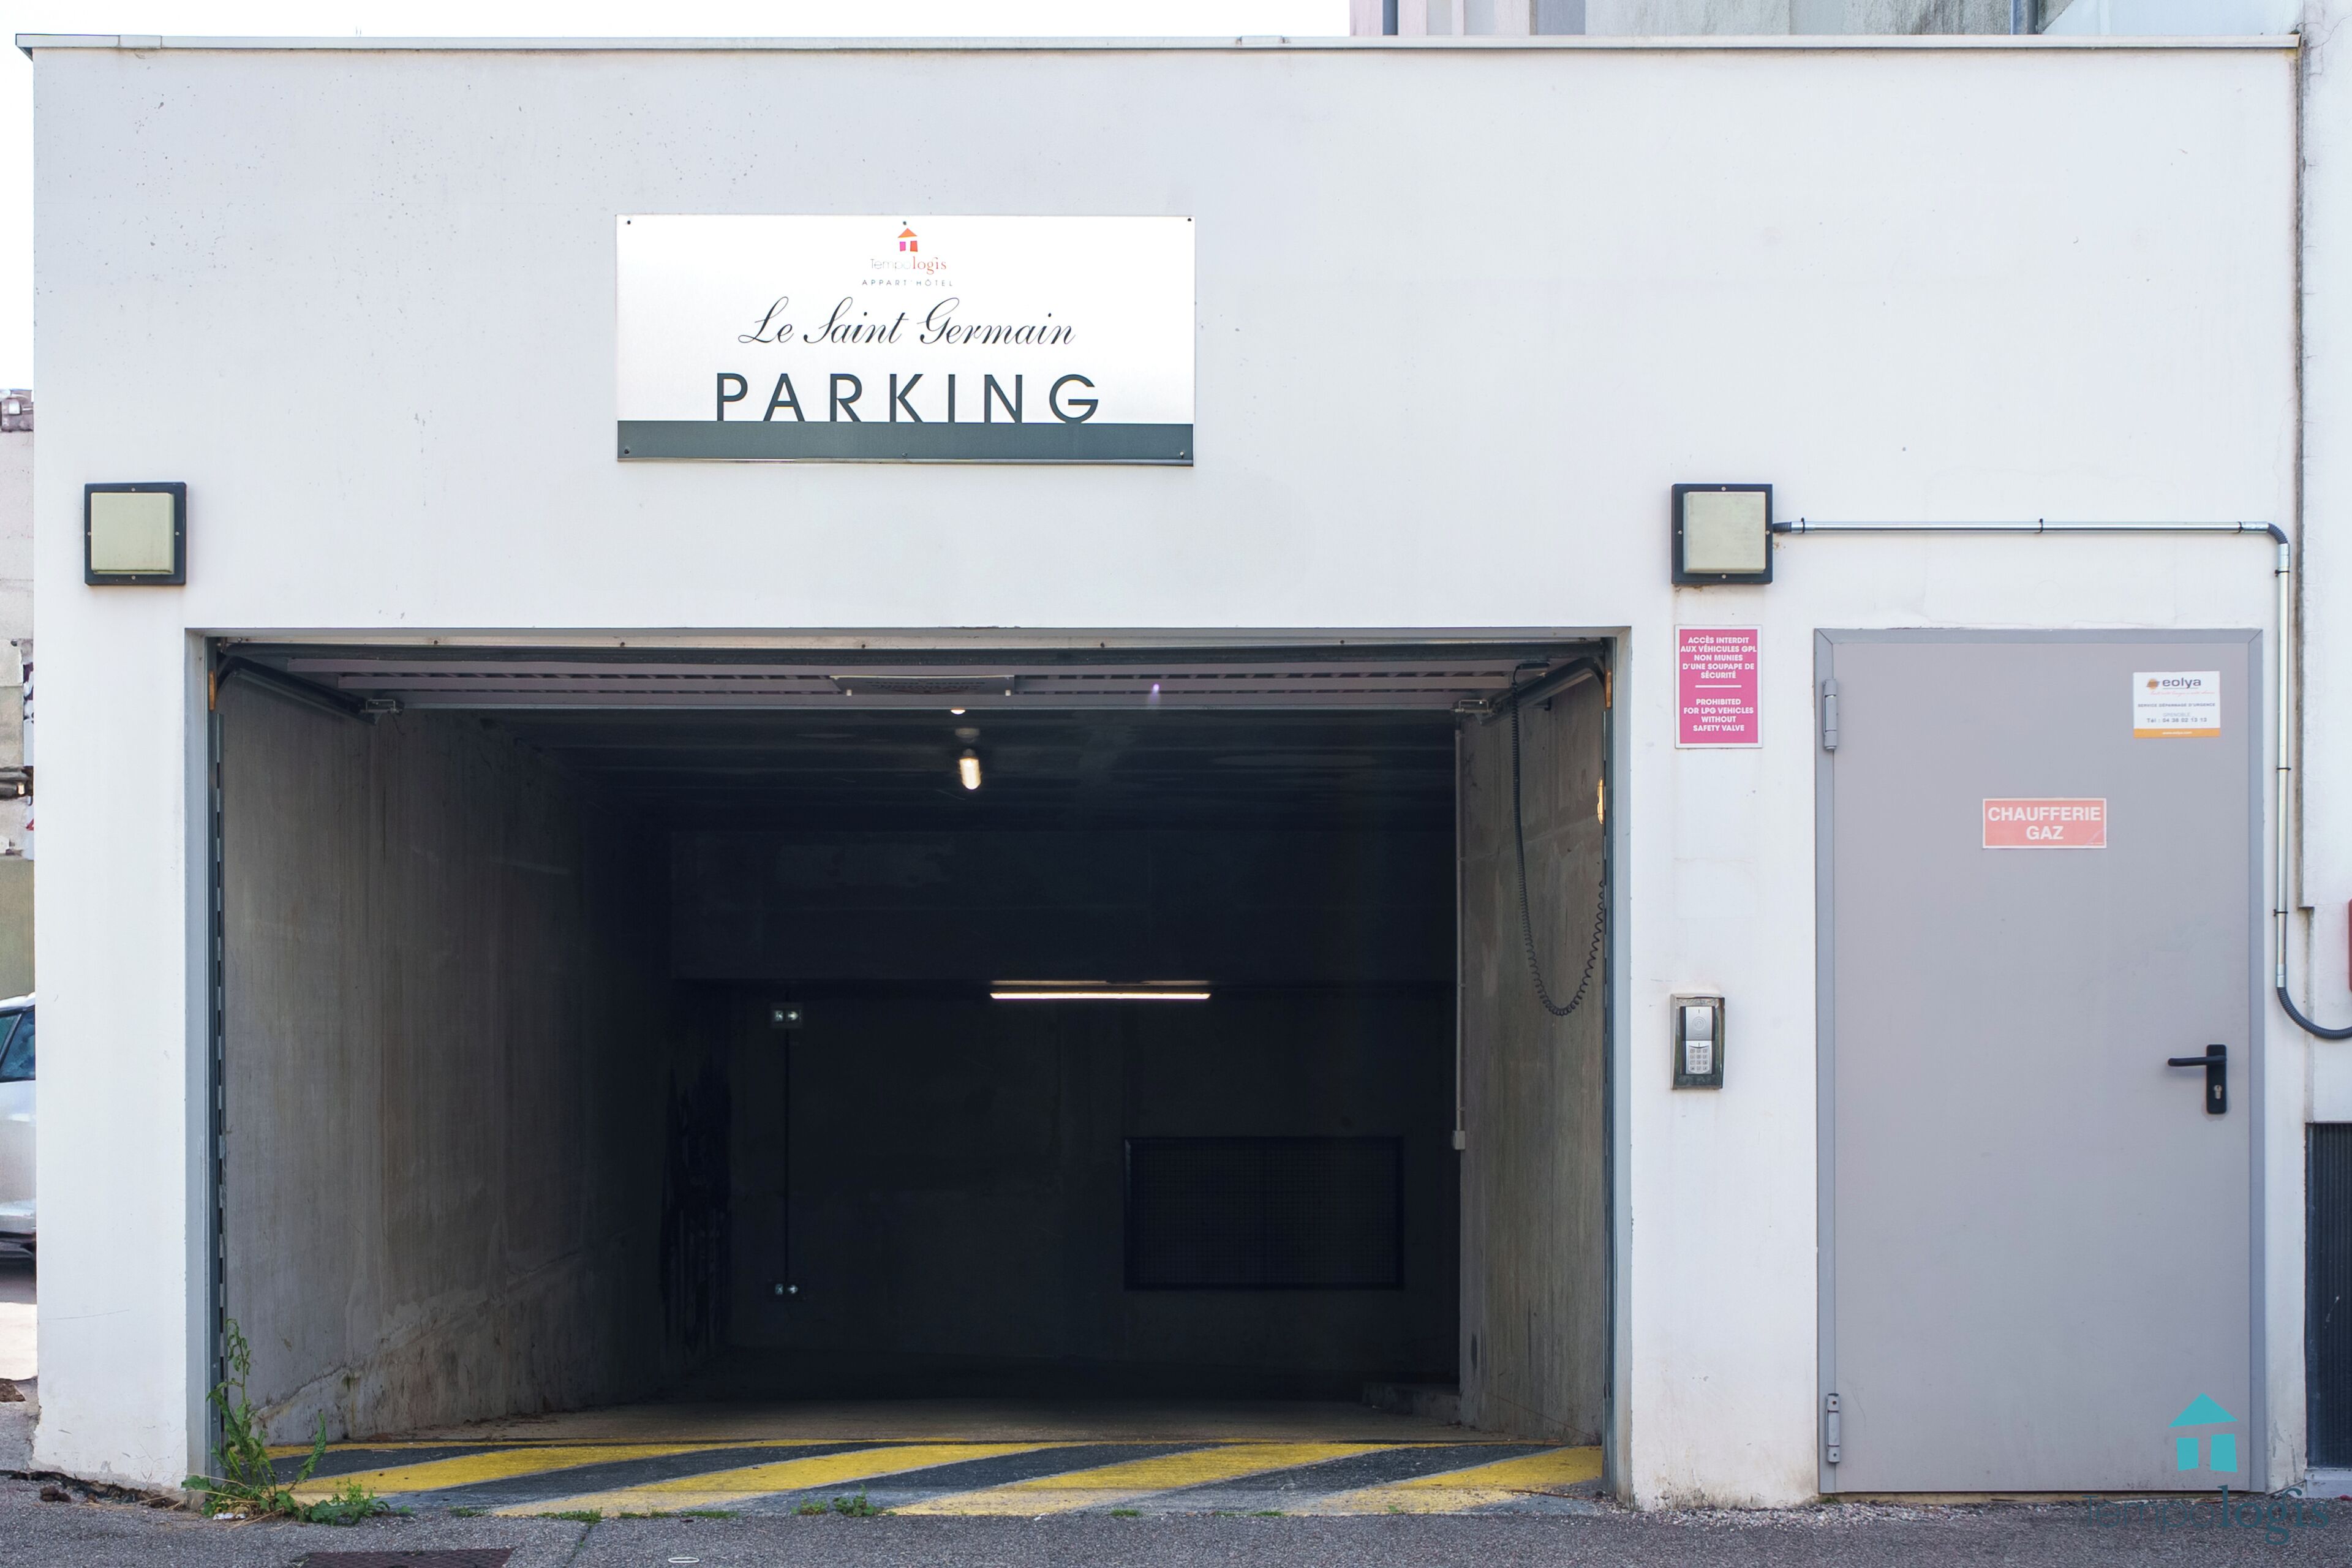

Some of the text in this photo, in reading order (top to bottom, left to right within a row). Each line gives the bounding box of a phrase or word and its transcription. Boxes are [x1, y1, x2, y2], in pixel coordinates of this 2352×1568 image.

[870, 256, 947, 275] Tempologis
[738, 296, 1077, 345] Le Saint Germain
[717, 372, 1099, 423] PARKING
[1687, 635, 1714, 644] ACCÈS
[1698, 644, 1740, 652] VÉHICULES
[2162, 677, 2201, 689] eolya
[1988, 807, 2101, 821] CHAUFFERIE
[2026, 825, 2064, 840] GAZ
